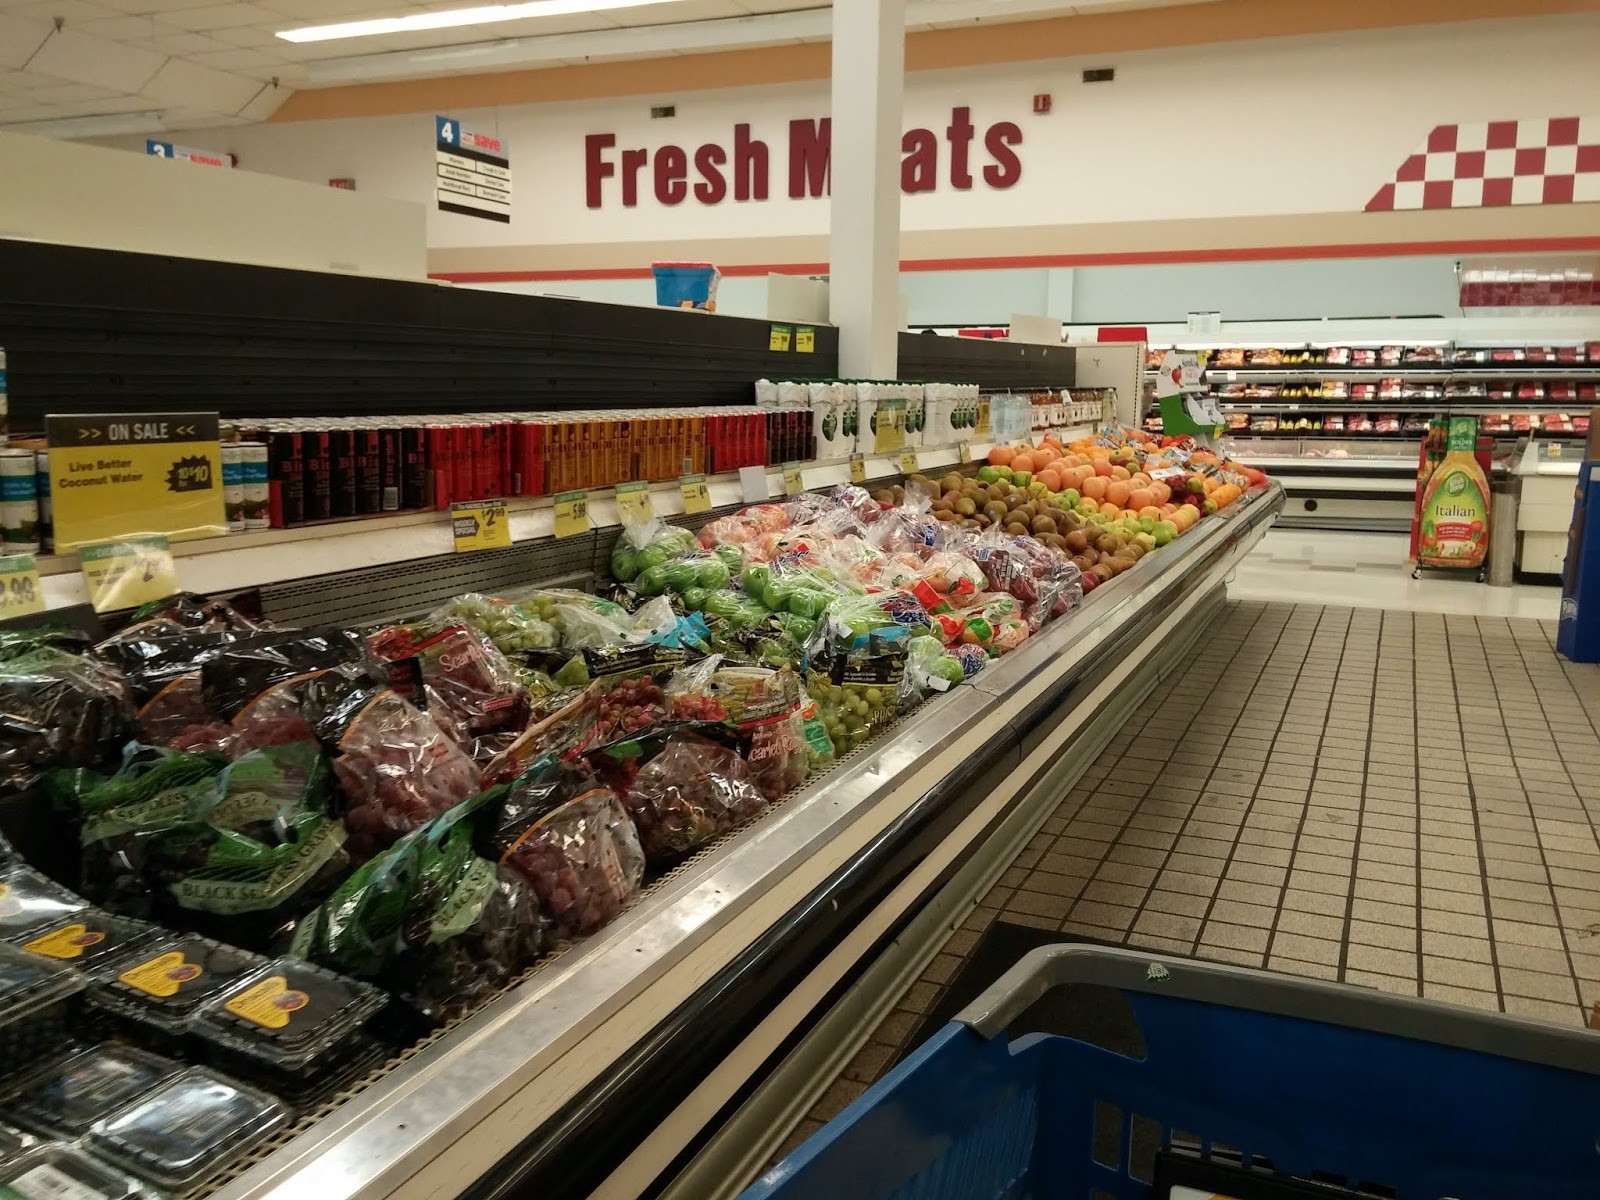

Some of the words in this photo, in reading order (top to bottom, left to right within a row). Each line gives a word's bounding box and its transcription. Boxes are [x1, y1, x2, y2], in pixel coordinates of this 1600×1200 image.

[441, 121, 454, 143] 4
[474, 134, 501, 152] save
[585, 122, 769, 209] Fresh
[788, 105, 1024, 200] Mats
[108, 423, 130, 440] ON
[133, 422, 170, 440] SALE
[69, 461, 94, 473] Live
[97, 459, 132, 471] Better
[59, 475, 107, 489] Coconut
[110, 472, 143, 484] Water
[1435, 504, 1476, 518] Italian
